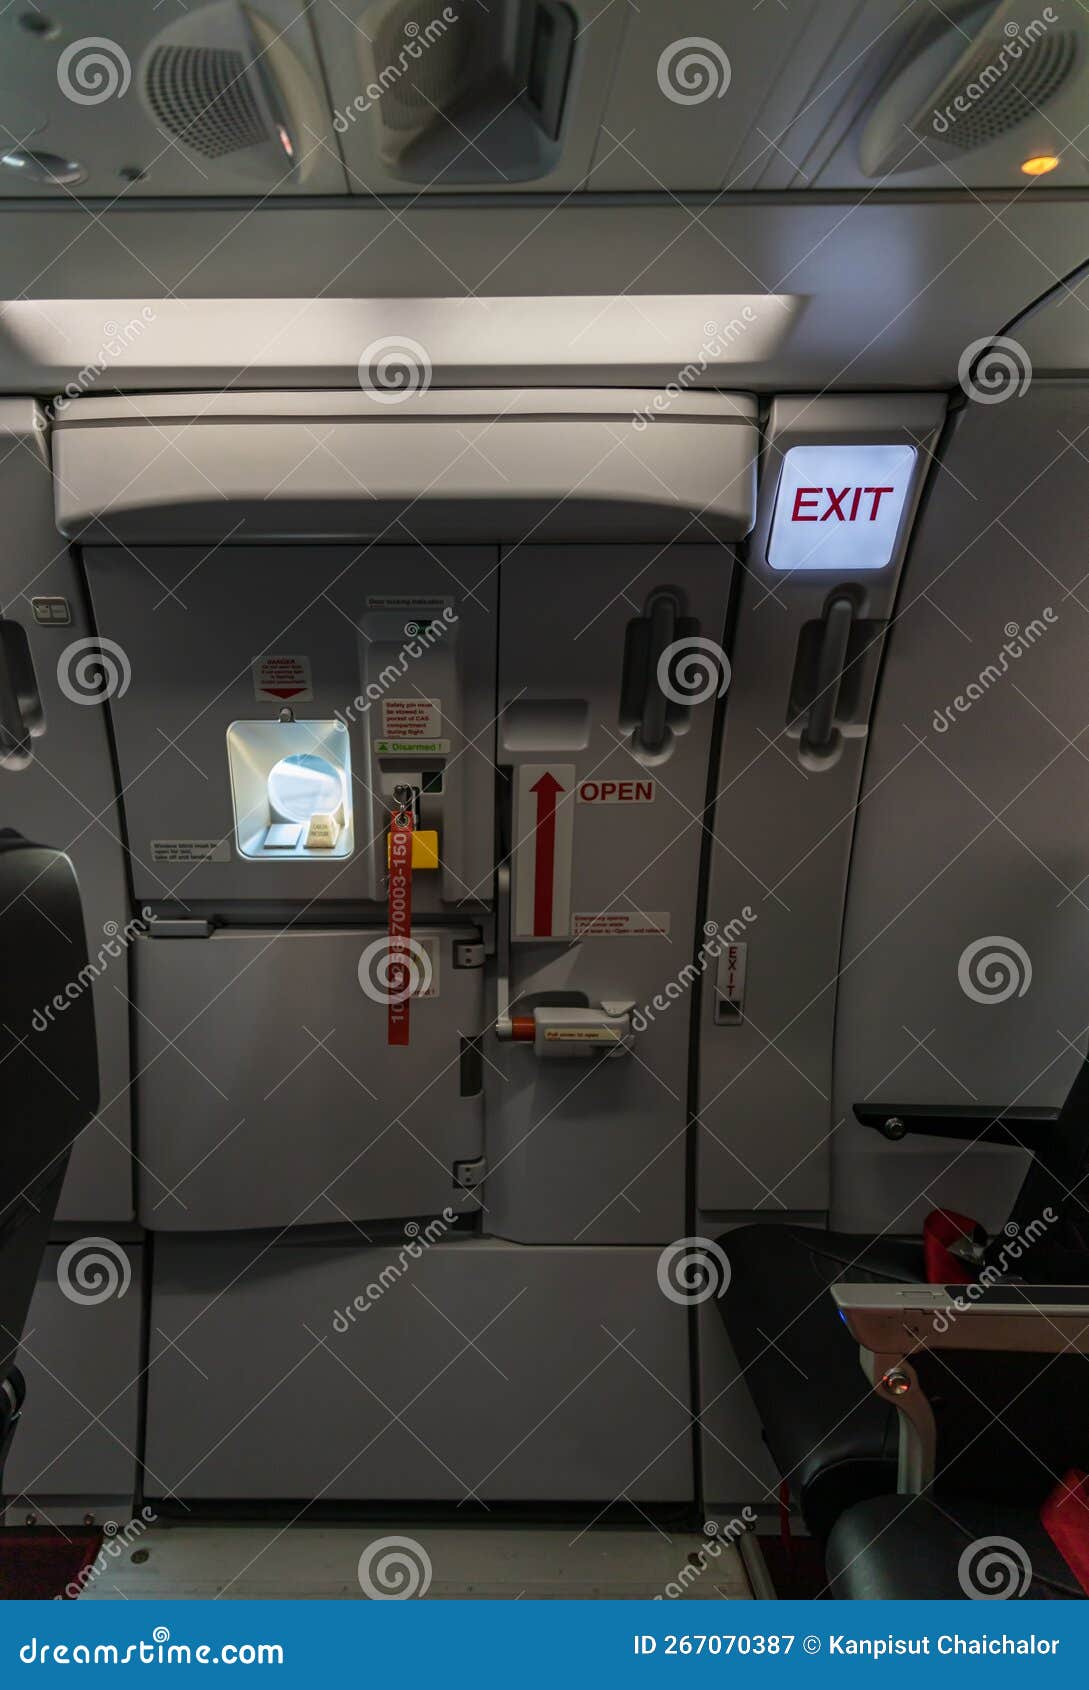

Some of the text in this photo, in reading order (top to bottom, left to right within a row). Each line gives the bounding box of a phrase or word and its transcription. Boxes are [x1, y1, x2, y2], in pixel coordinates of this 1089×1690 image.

[791, 487, 894, 522] EXIT
[392, 743, 436, 751] Disarmed
[580, 783, 652, 801] OPEN
[727, 946, 738, 996] EXIT
